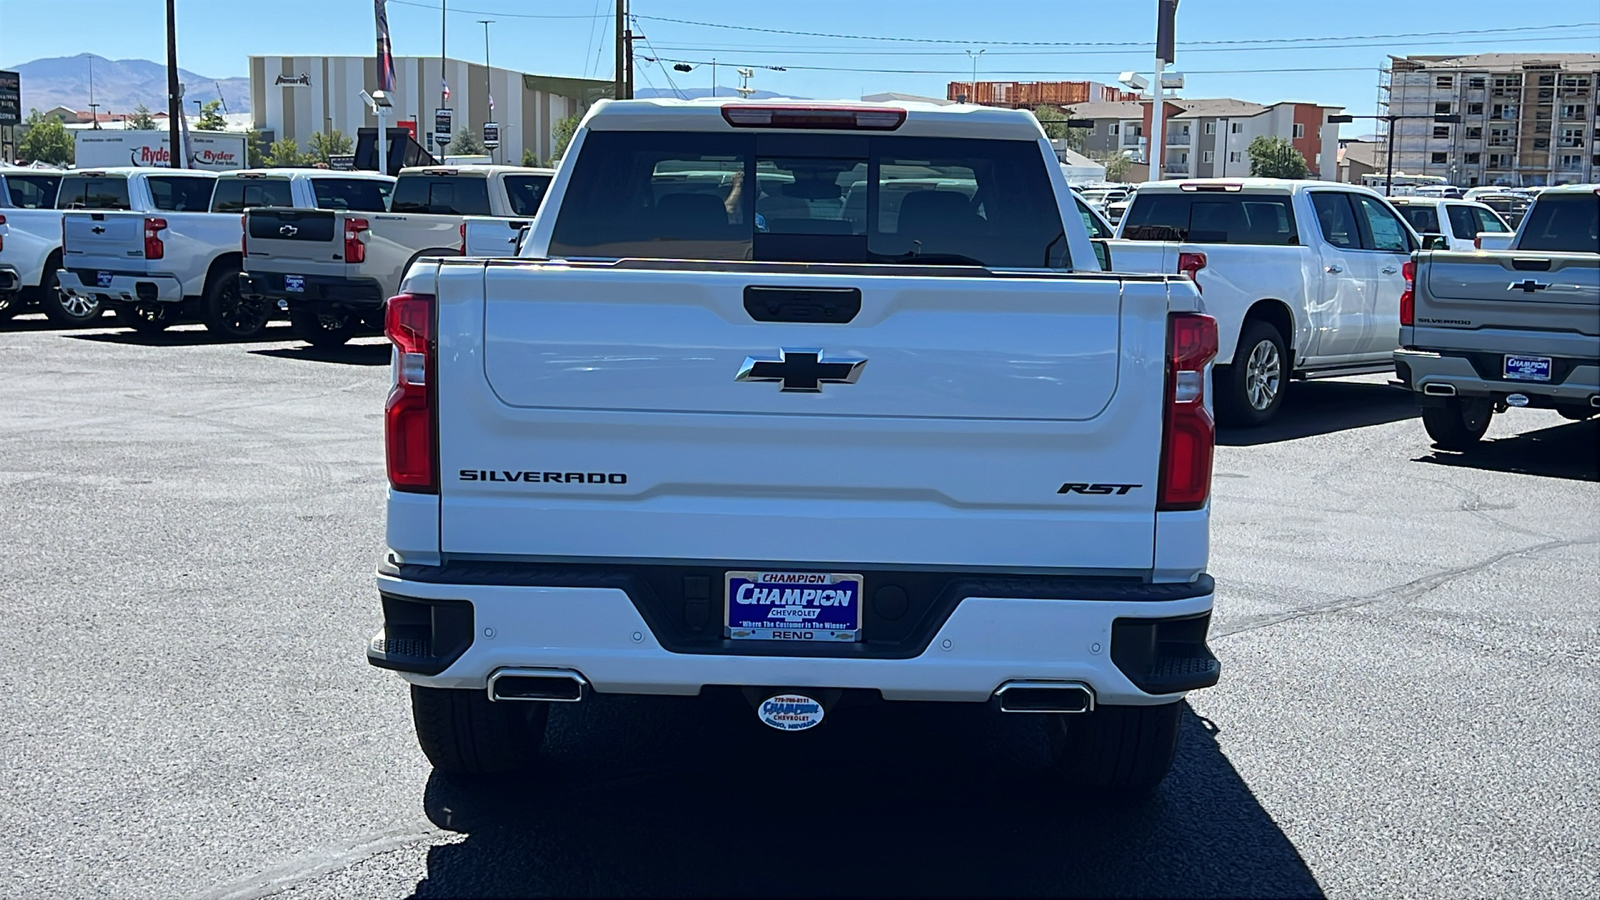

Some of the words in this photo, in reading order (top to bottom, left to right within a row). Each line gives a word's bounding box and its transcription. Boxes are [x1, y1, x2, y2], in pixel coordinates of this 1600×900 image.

[141, 146, 170, 165] Ryde
[204, 150, 235, 161] Ryder
[1418, 317, 1471, 325] SILVERADO
[1508, 358, 1548, 369] CHAMPION
[459, 469, 627, 484] SILVERADO
[1056, 482, 1143, 495] RST
[762, 573, 826, 584] CHAMPION
[736, 583, 852, 607] CHAMPION
[771, 609, 817, 617] CHEVROLET
[776, 621, 804, 629] Customer
[772, 631, 814, 640] RENO
